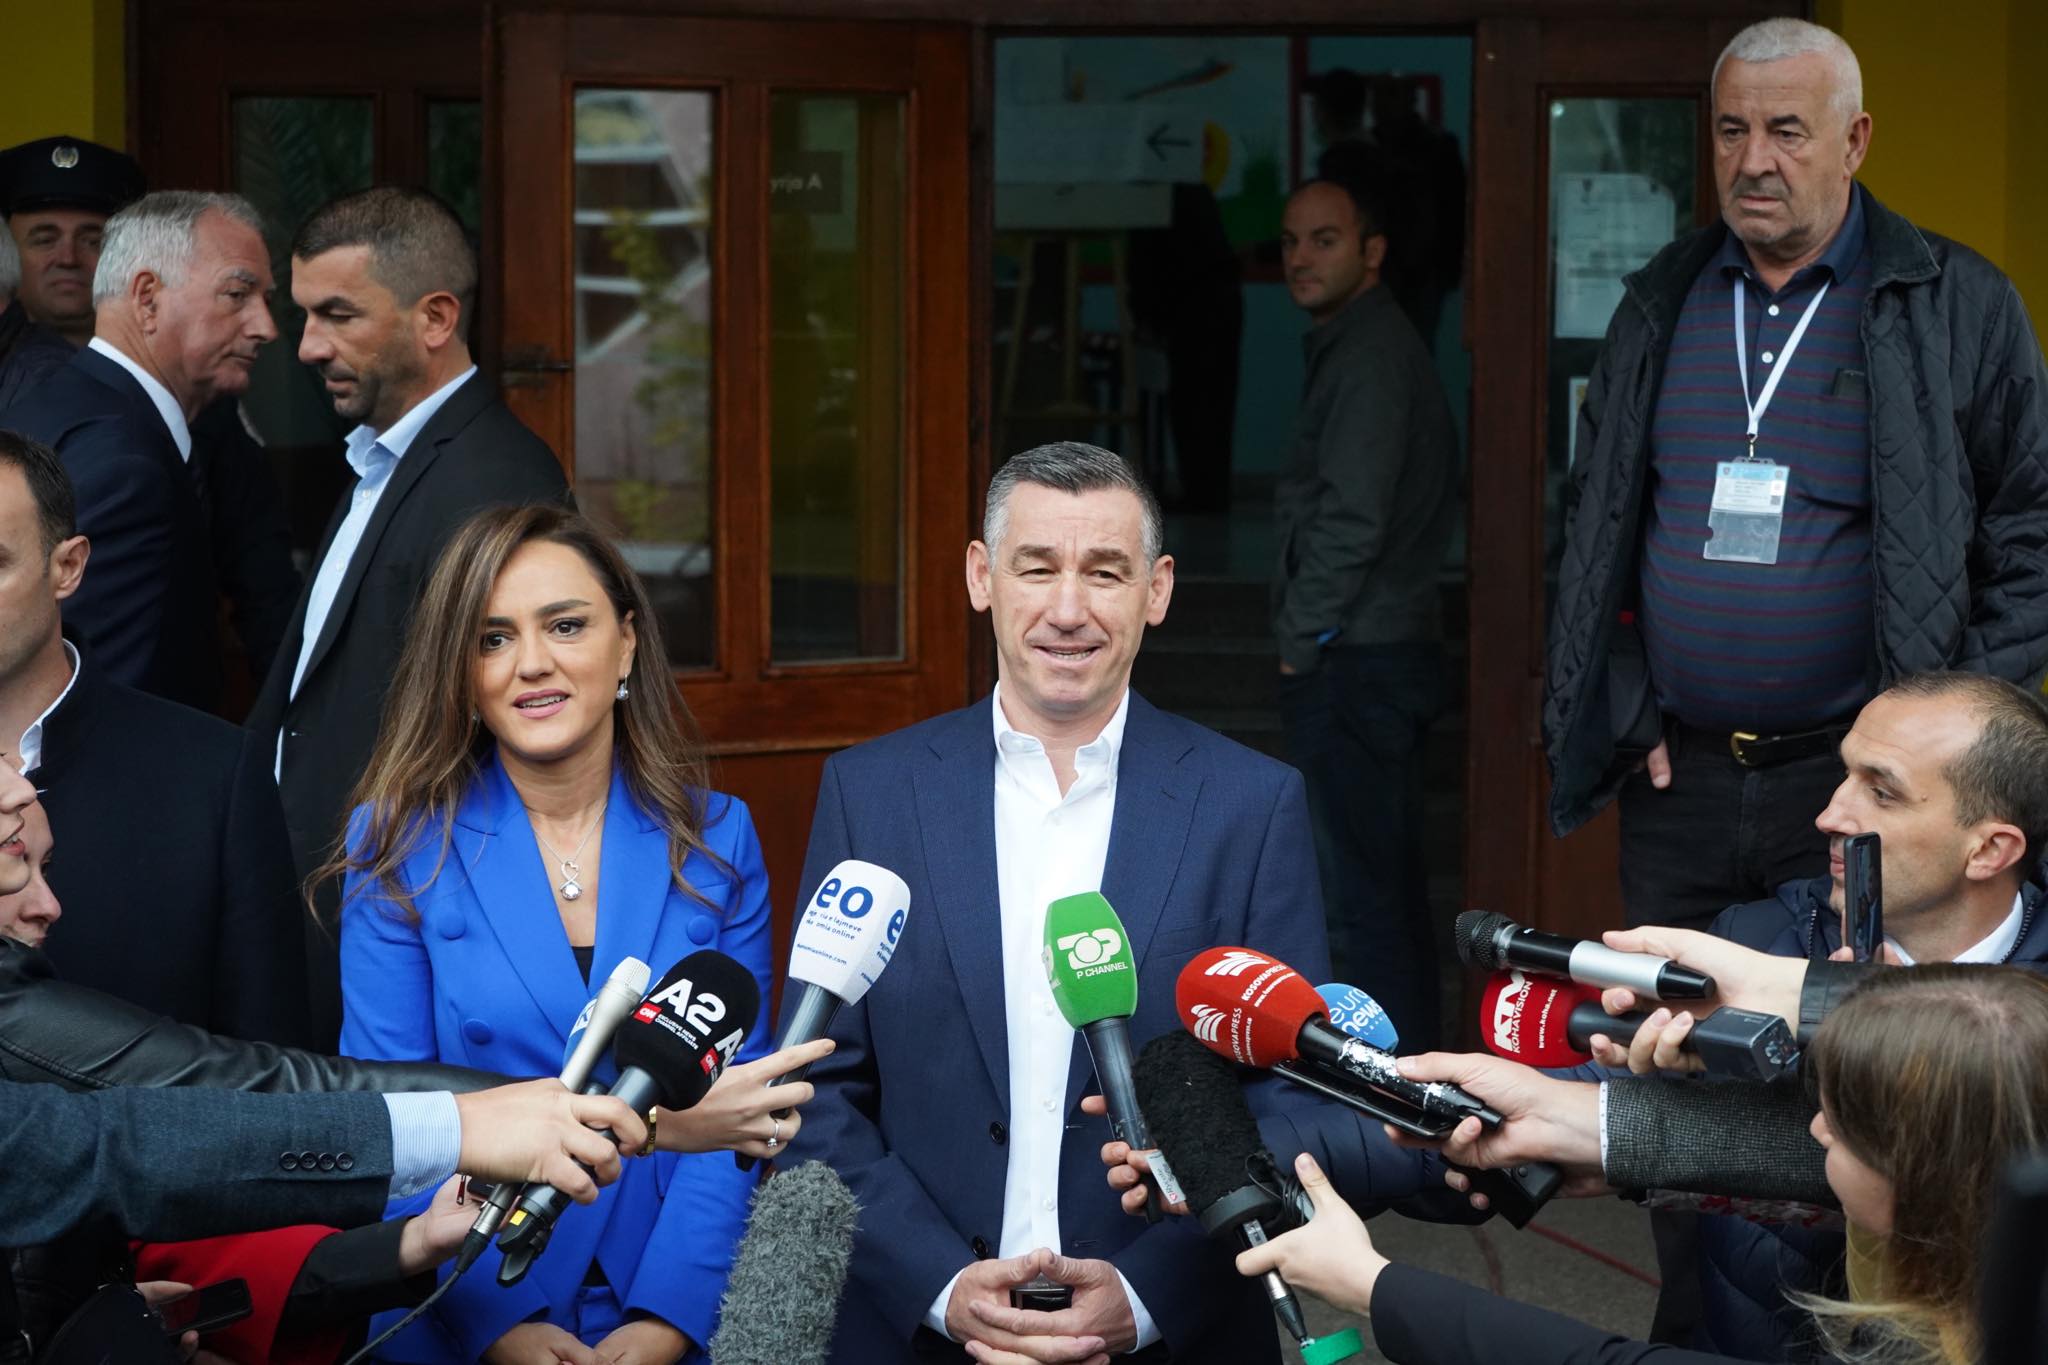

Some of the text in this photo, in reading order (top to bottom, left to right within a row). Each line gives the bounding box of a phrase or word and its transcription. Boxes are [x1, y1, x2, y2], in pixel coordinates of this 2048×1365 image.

[806, 172, 823, 190] A
[816, 877, 874, 919] eo
[831, 926, 855, 941] online
[1085, 961, 1129, 977] CHANNEL
[649, 978, 726, 1036] A2
[1329, 988, 1369, 1025] euro
[1511, 981, 1534, 1053] KOHAVISION
[1539, 989, 1558, 1049] www.koha.net
